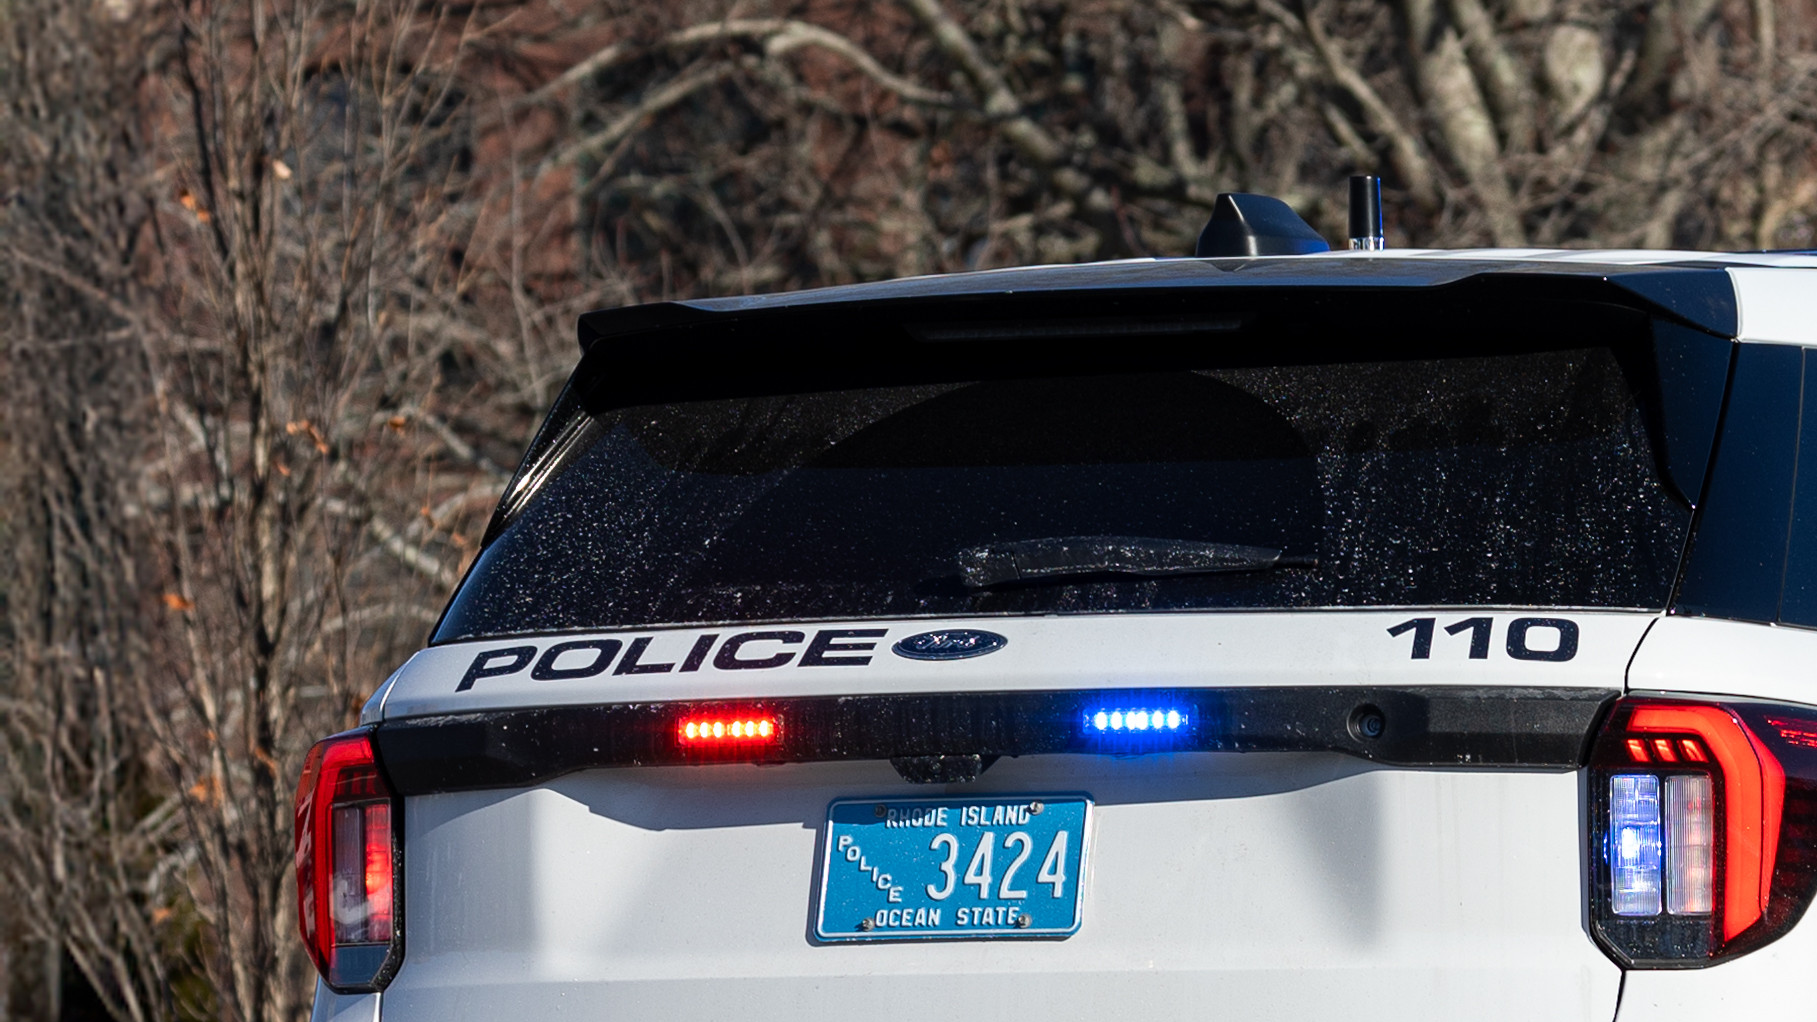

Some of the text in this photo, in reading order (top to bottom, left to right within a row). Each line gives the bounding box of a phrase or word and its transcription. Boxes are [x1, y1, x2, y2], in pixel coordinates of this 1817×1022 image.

[453, 628, 889, 693] POLICE
[1386, 617, 1580, 664] 110
[886, 805, 1032, 828] RHODE ISLAND
[838, 834, 904, 903] POLICE
[925, 830, 1070, 901] 3424
[875, 906, 1020, 928] OCEAN STATE
